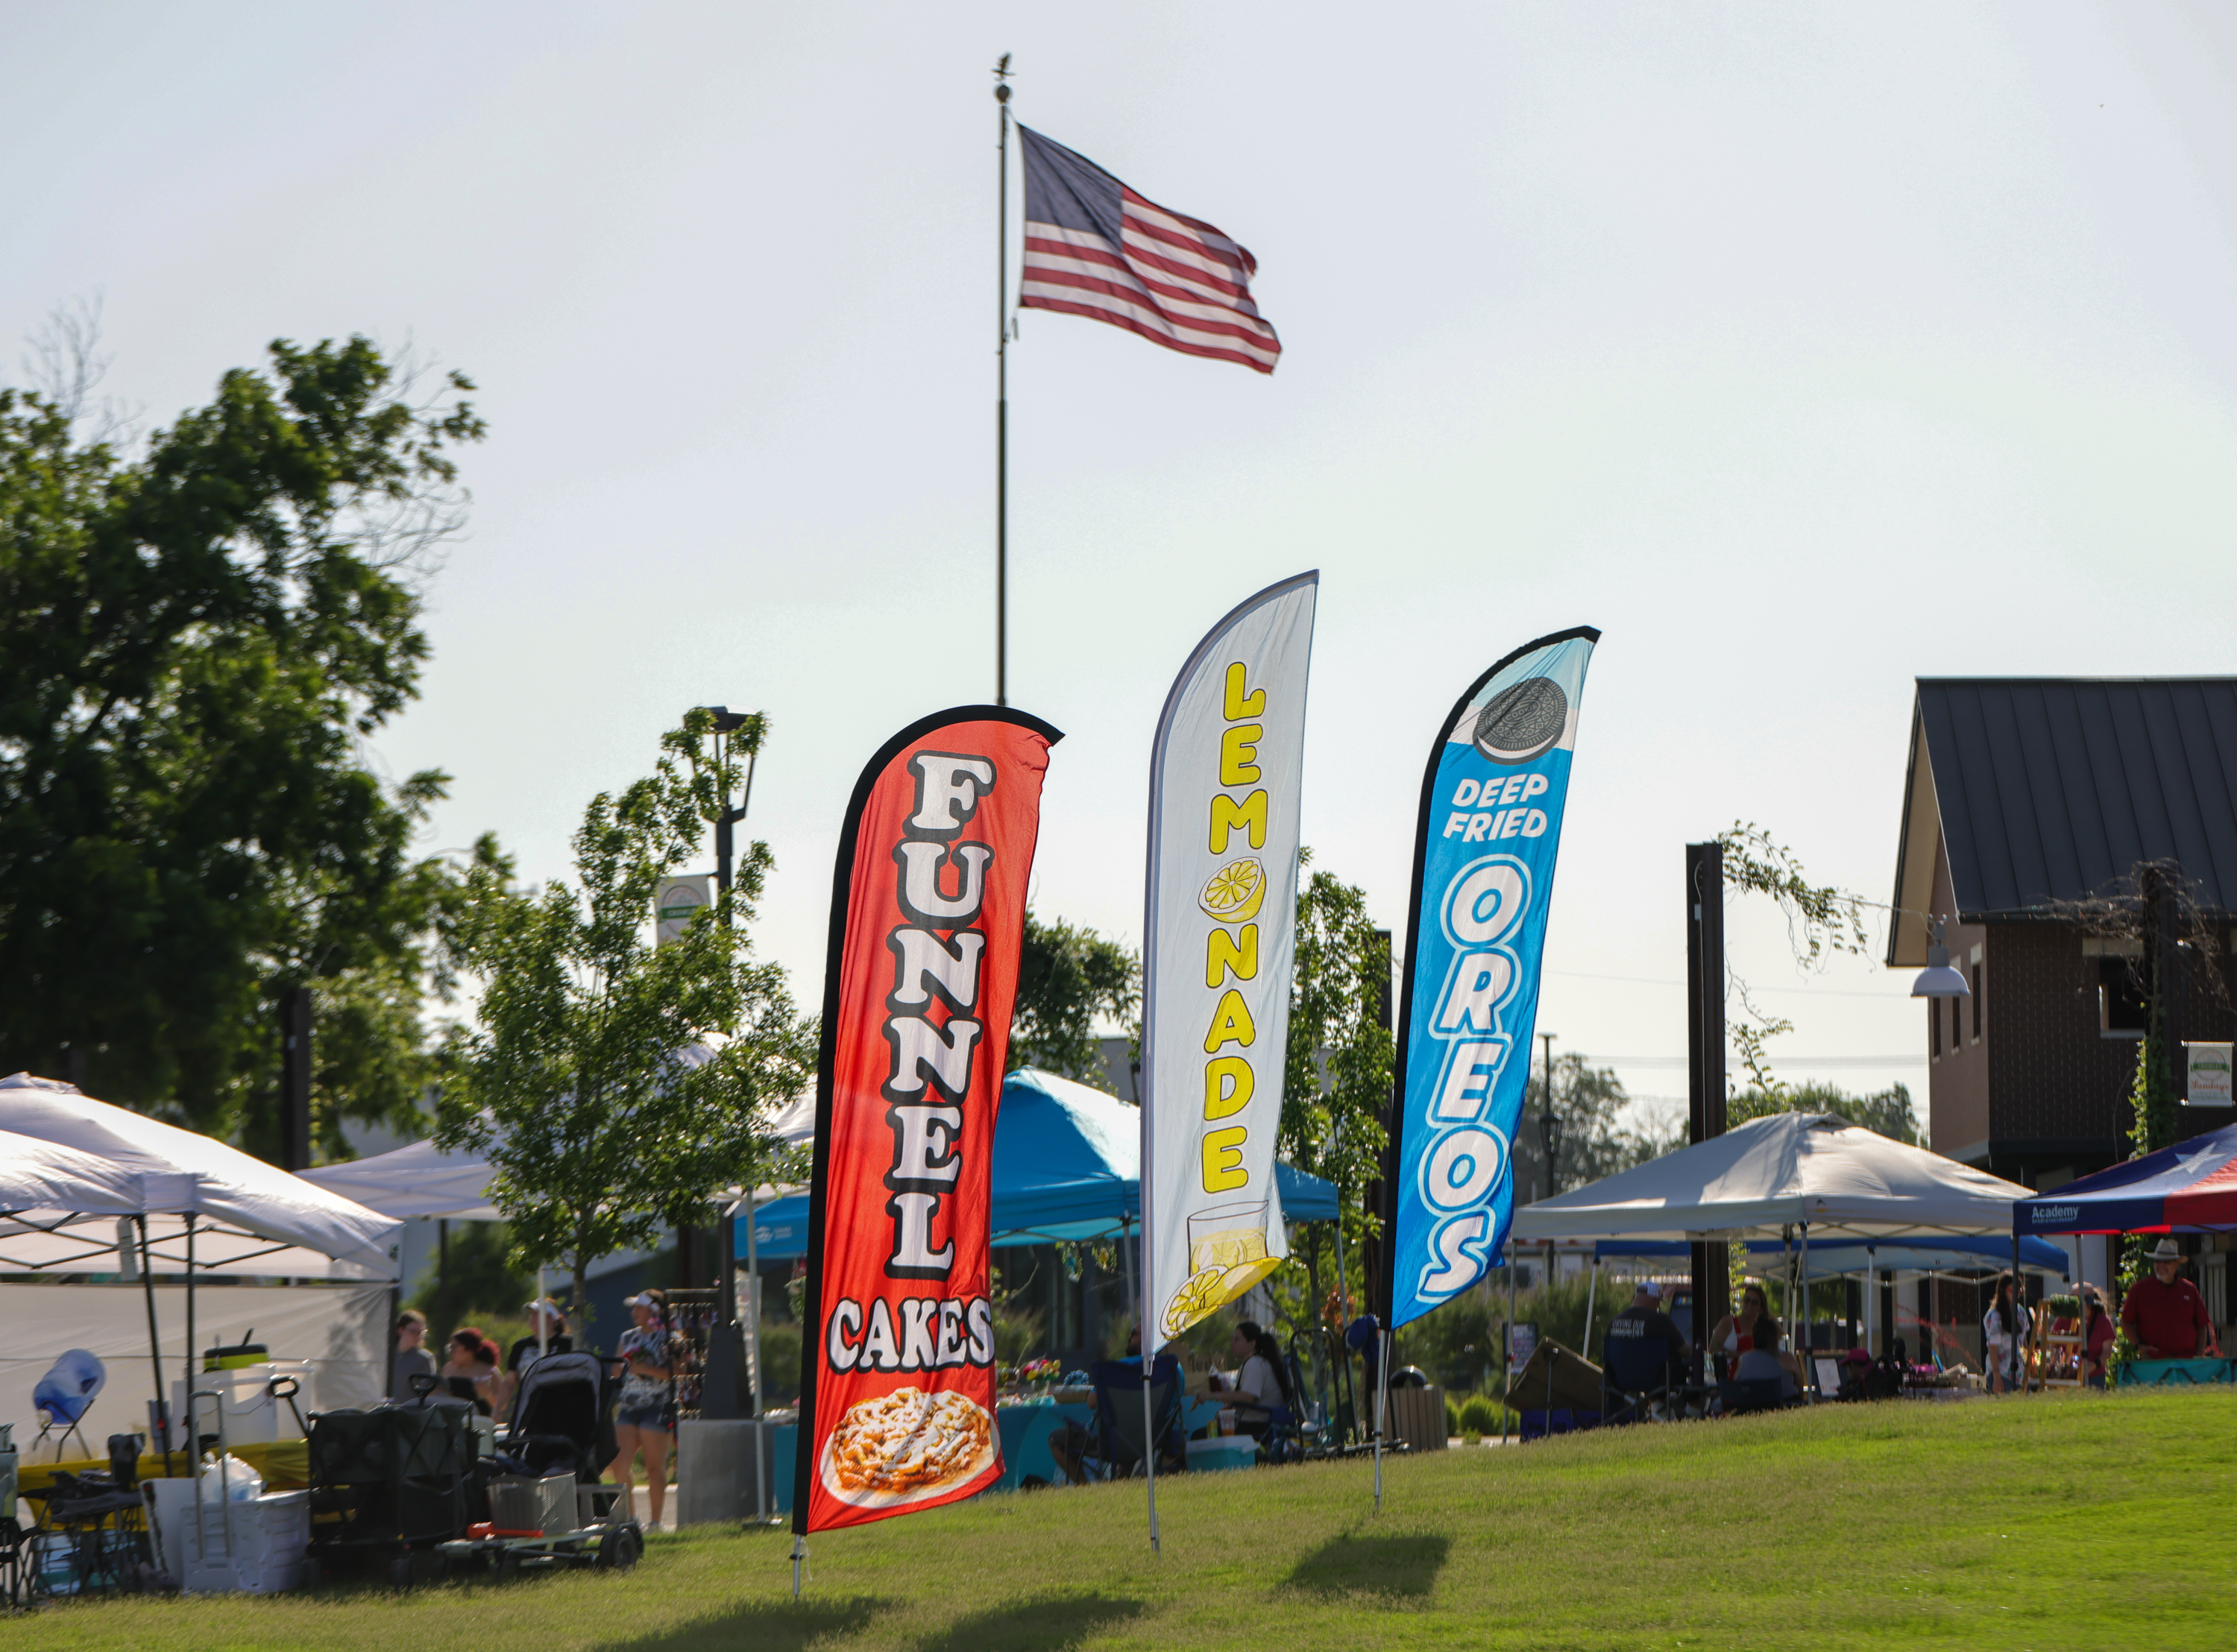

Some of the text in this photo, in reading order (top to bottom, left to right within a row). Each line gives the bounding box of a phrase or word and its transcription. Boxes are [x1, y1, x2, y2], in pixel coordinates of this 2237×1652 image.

[1451, 773, 1549, 808] DEEP
[1442, 807, 1548, 843] FRIED
[884, 750, 997, 1281] FUNNEL
[1416, 854, 1532, 1303] OREOS
[2032, 1205, 2078, 1221] Academy
[825, 1296, 995, 1375] CAKES
